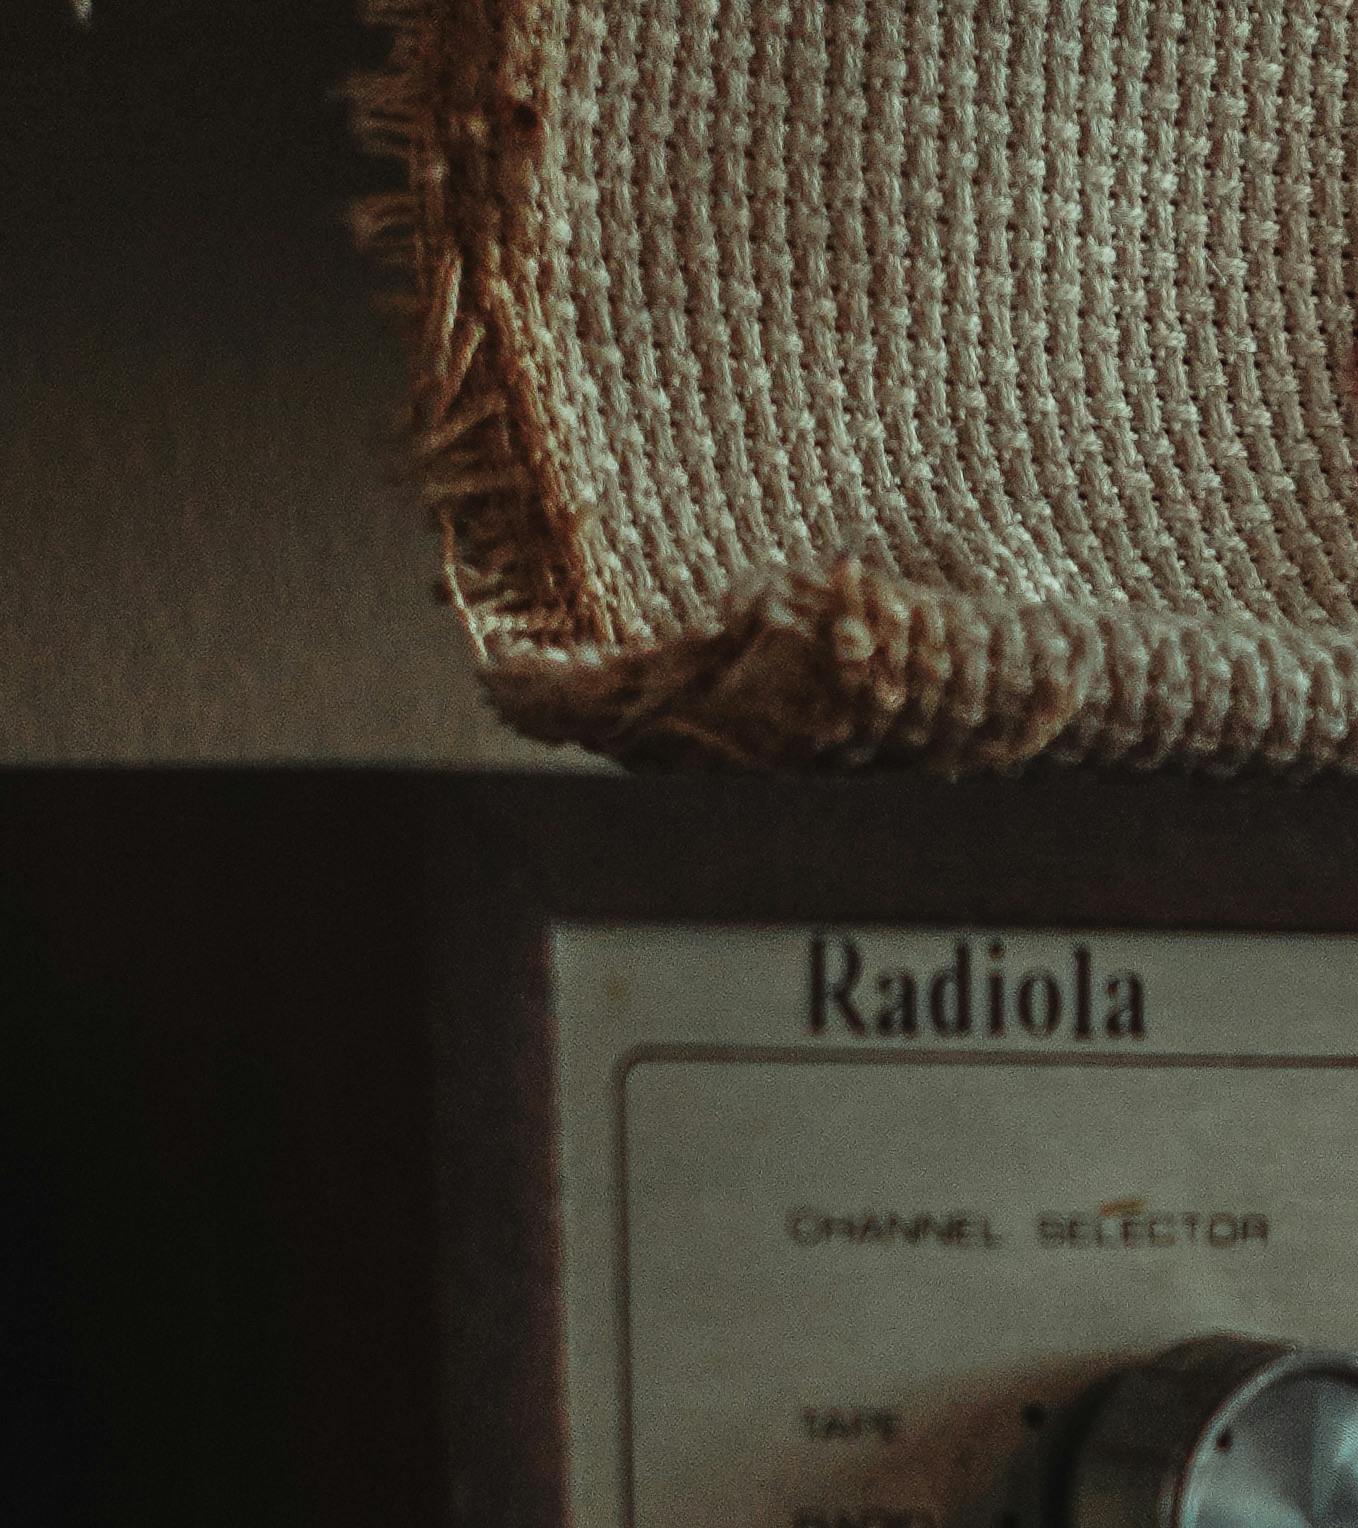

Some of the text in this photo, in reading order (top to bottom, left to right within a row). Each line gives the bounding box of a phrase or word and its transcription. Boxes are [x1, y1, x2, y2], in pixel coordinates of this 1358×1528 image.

[807, 936, 1146, 1041] Radiola
[788, 1213, 1269, 1248] CHANNEL SELECTOR
